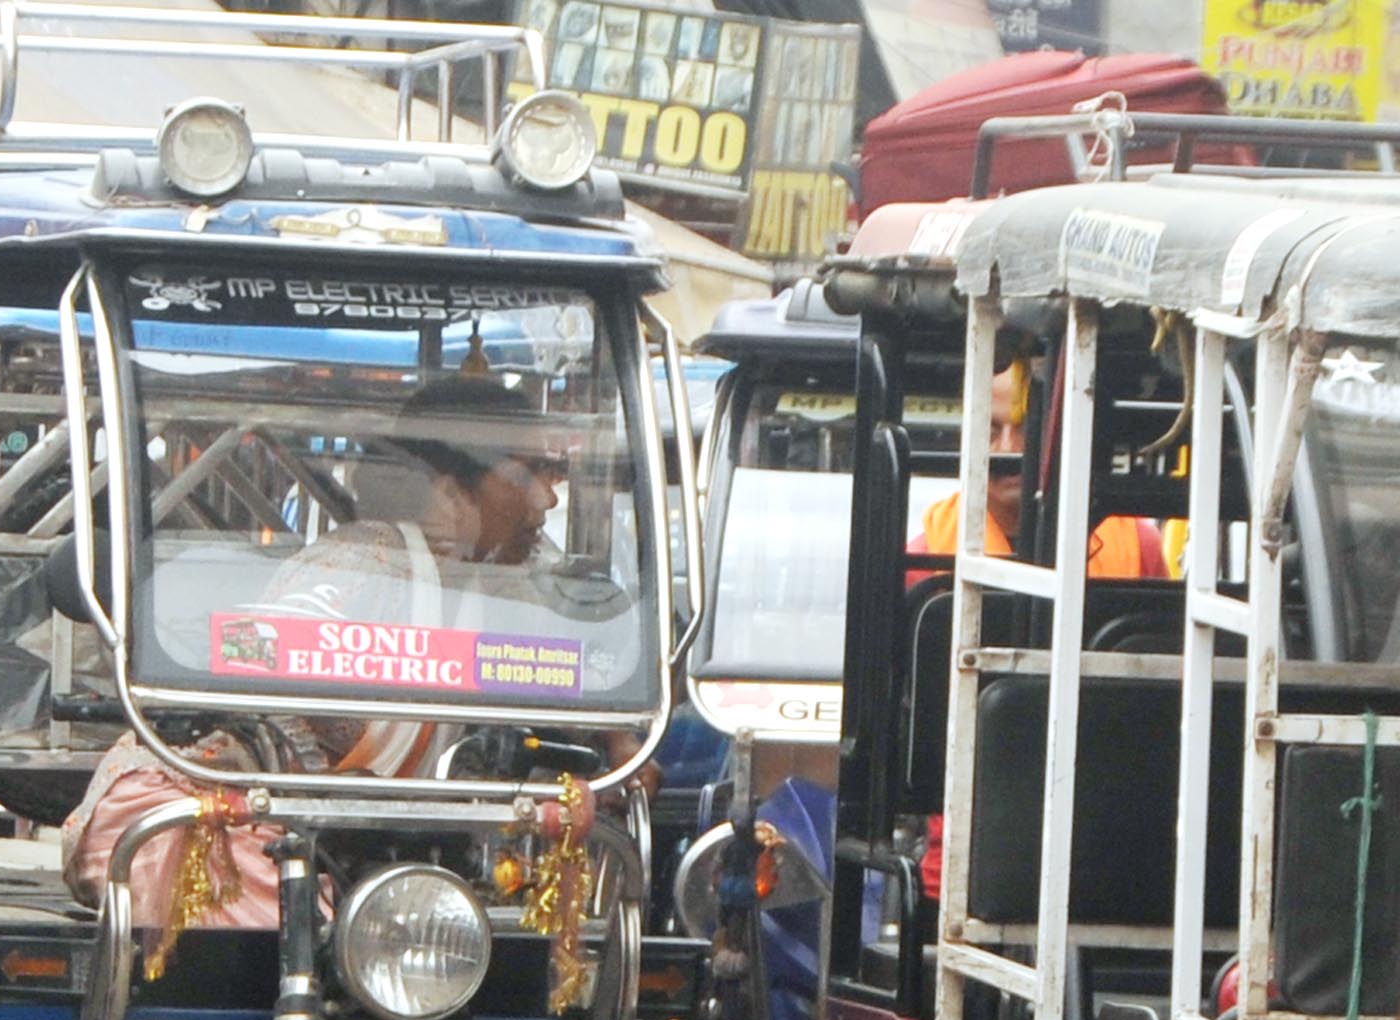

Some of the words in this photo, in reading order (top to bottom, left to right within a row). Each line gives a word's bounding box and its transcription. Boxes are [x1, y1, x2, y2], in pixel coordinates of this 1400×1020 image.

[1218, 35, 1366, 76] PUNJABI
[1220, 70, 1360, 110] DHABA
[227, 277, 277, 299] MP
[286, 280, 446, 305] ELECTRIC
[790, 397, 844, 410] MP
[318, 622, 432, 658] SONU
[287, 650, 463, 686] ELECTRIC
